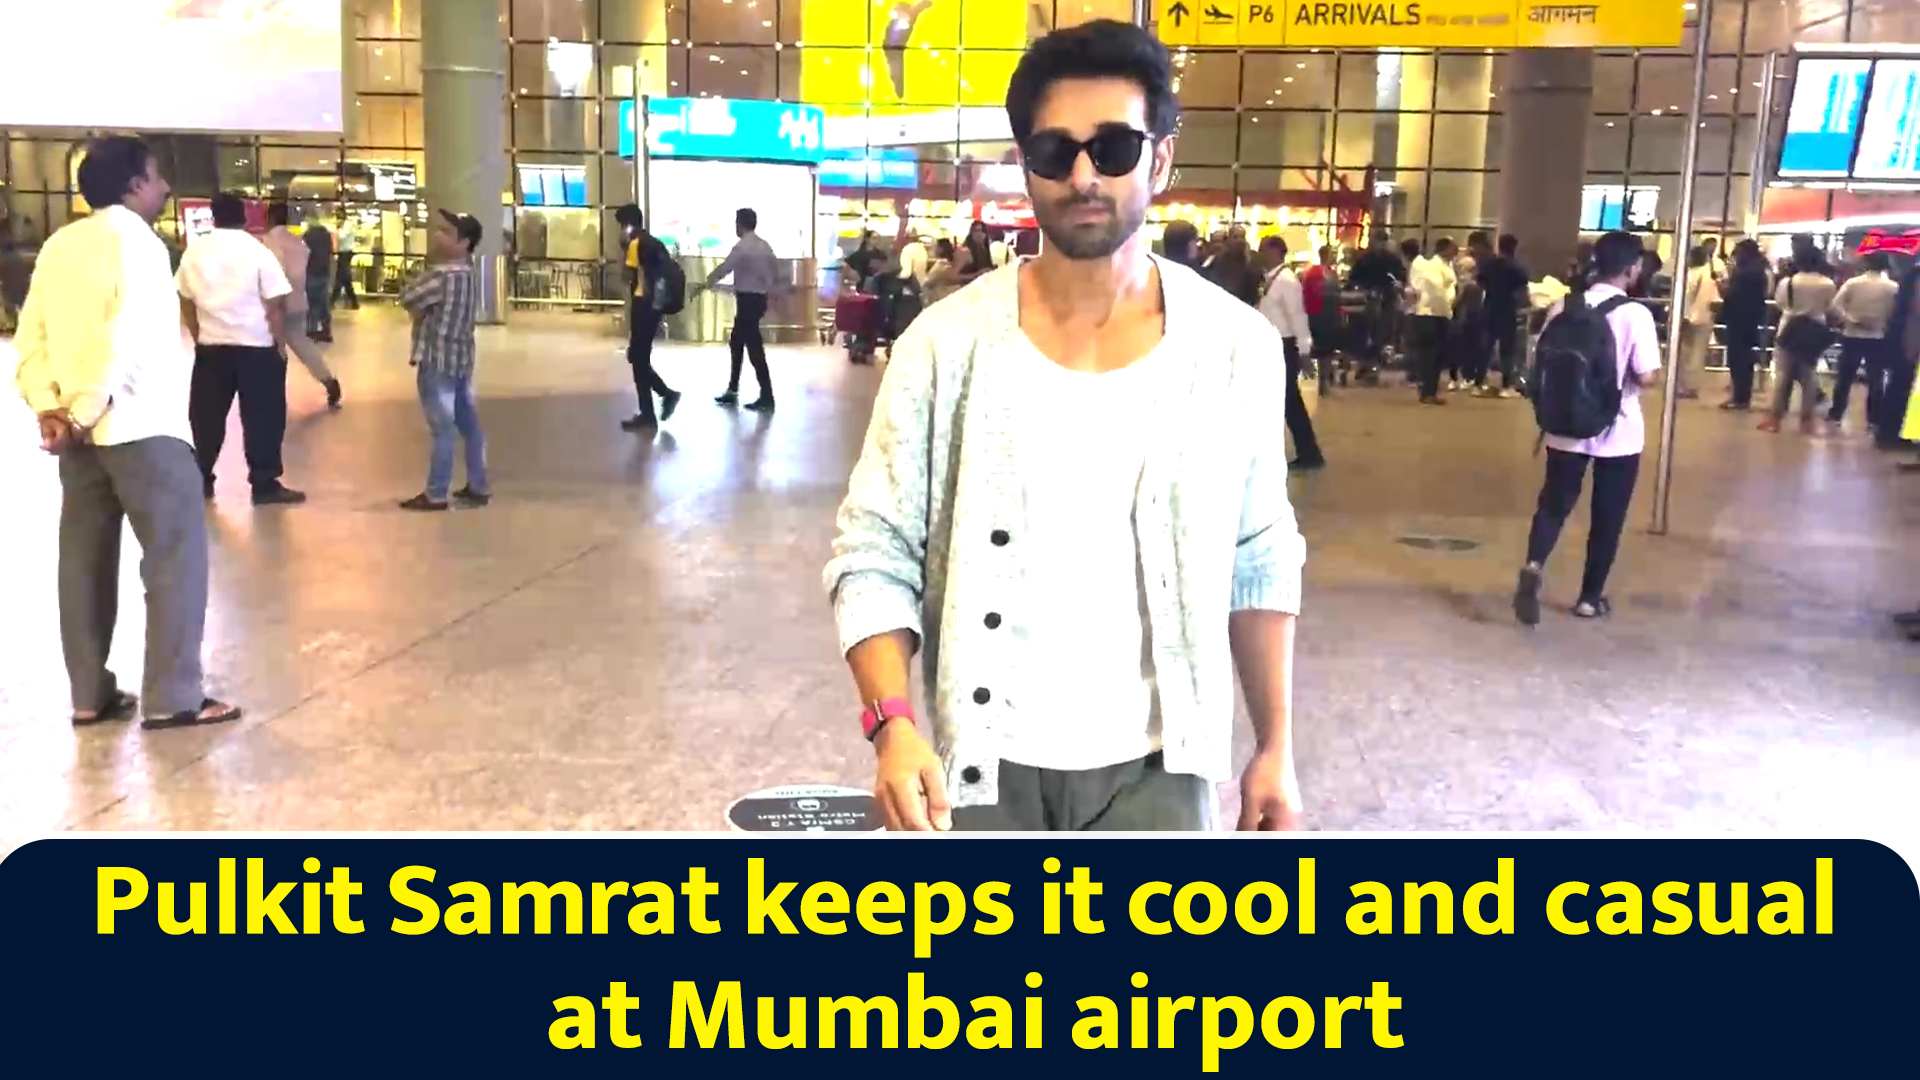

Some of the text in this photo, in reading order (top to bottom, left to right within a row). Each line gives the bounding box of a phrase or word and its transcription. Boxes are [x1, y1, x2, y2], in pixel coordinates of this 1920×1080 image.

[1249, 5, 1274, 23] P6
[1295, 4, 1420, 26] ARRIVALS
[1528, 5, 1599, 23] आगमन
